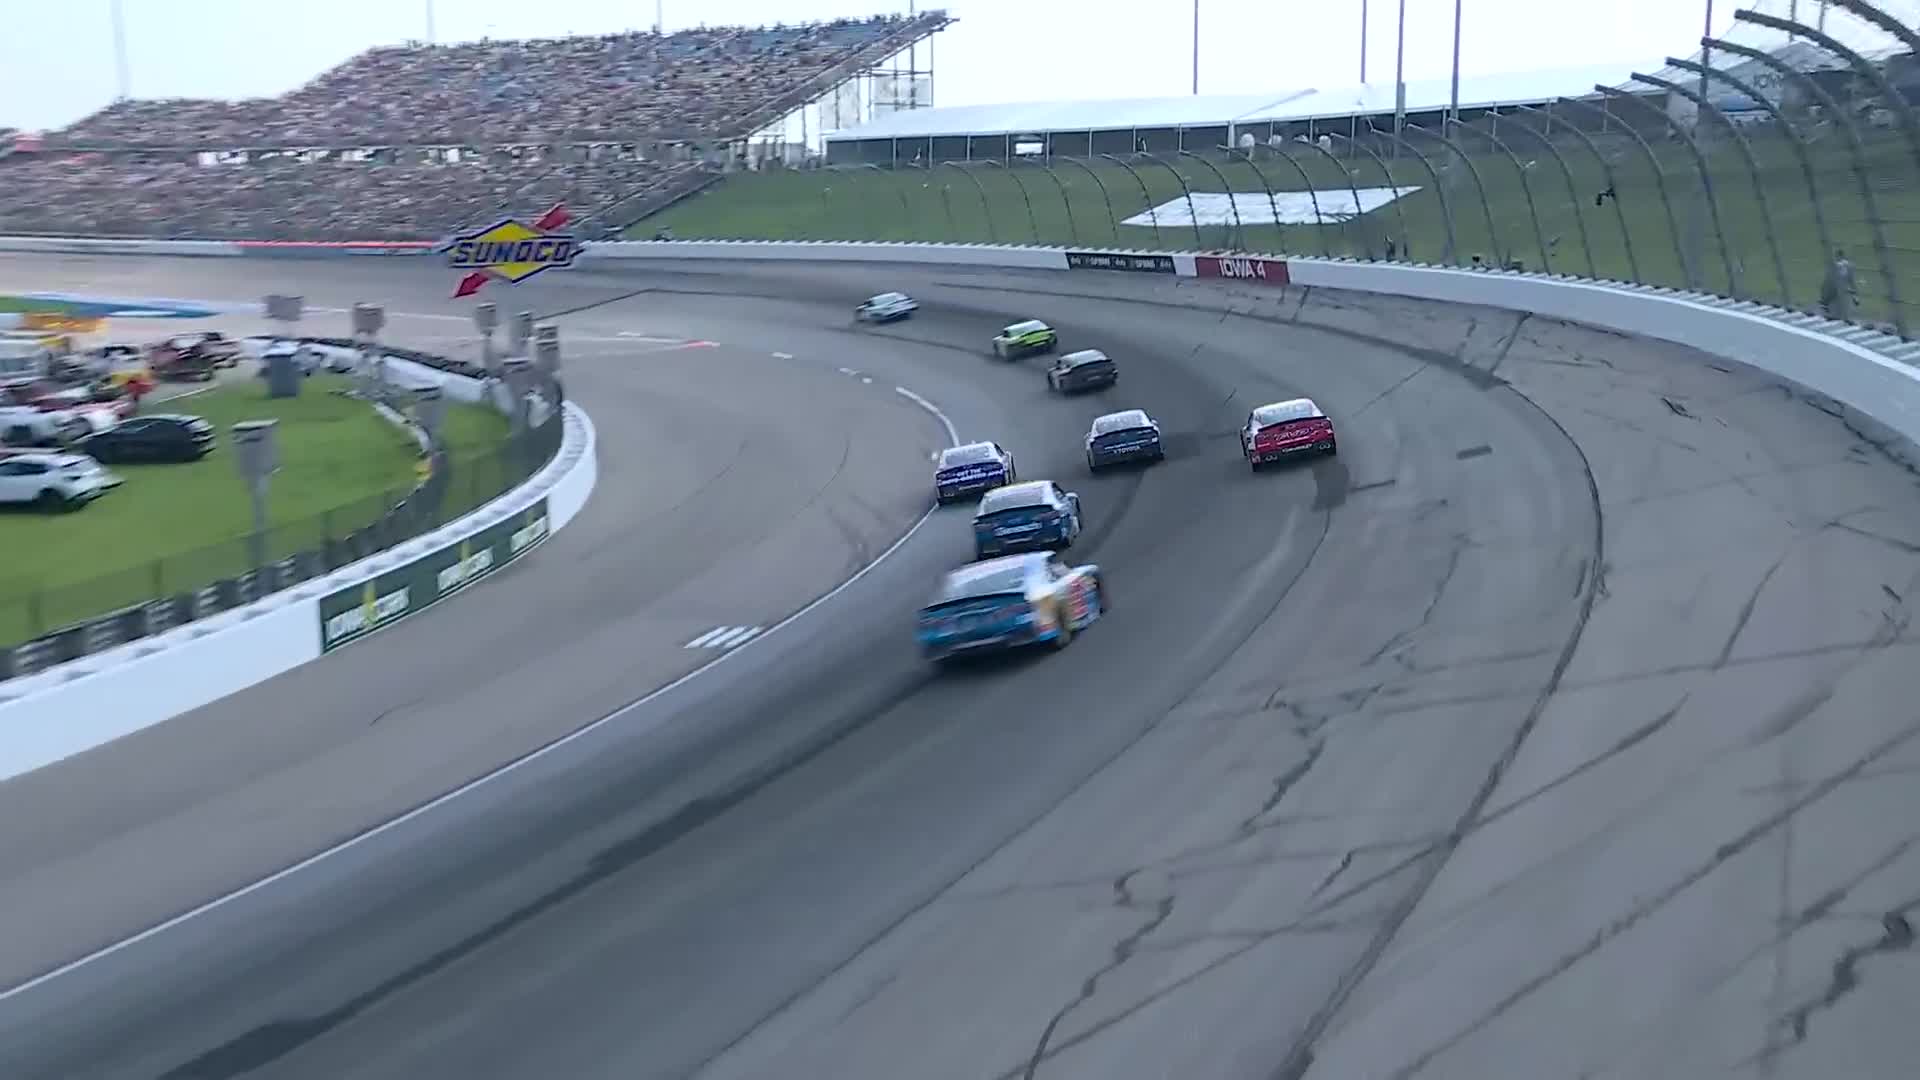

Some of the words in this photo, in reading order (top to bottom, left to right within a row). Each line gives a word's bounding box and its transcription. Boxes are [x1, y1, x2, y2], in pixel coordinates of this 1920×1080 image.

[455, 241, 571, 263] SUNOCO
[1219, 259, 1256, 278] IOWA
[1256, 261, 1266, 279] 4
